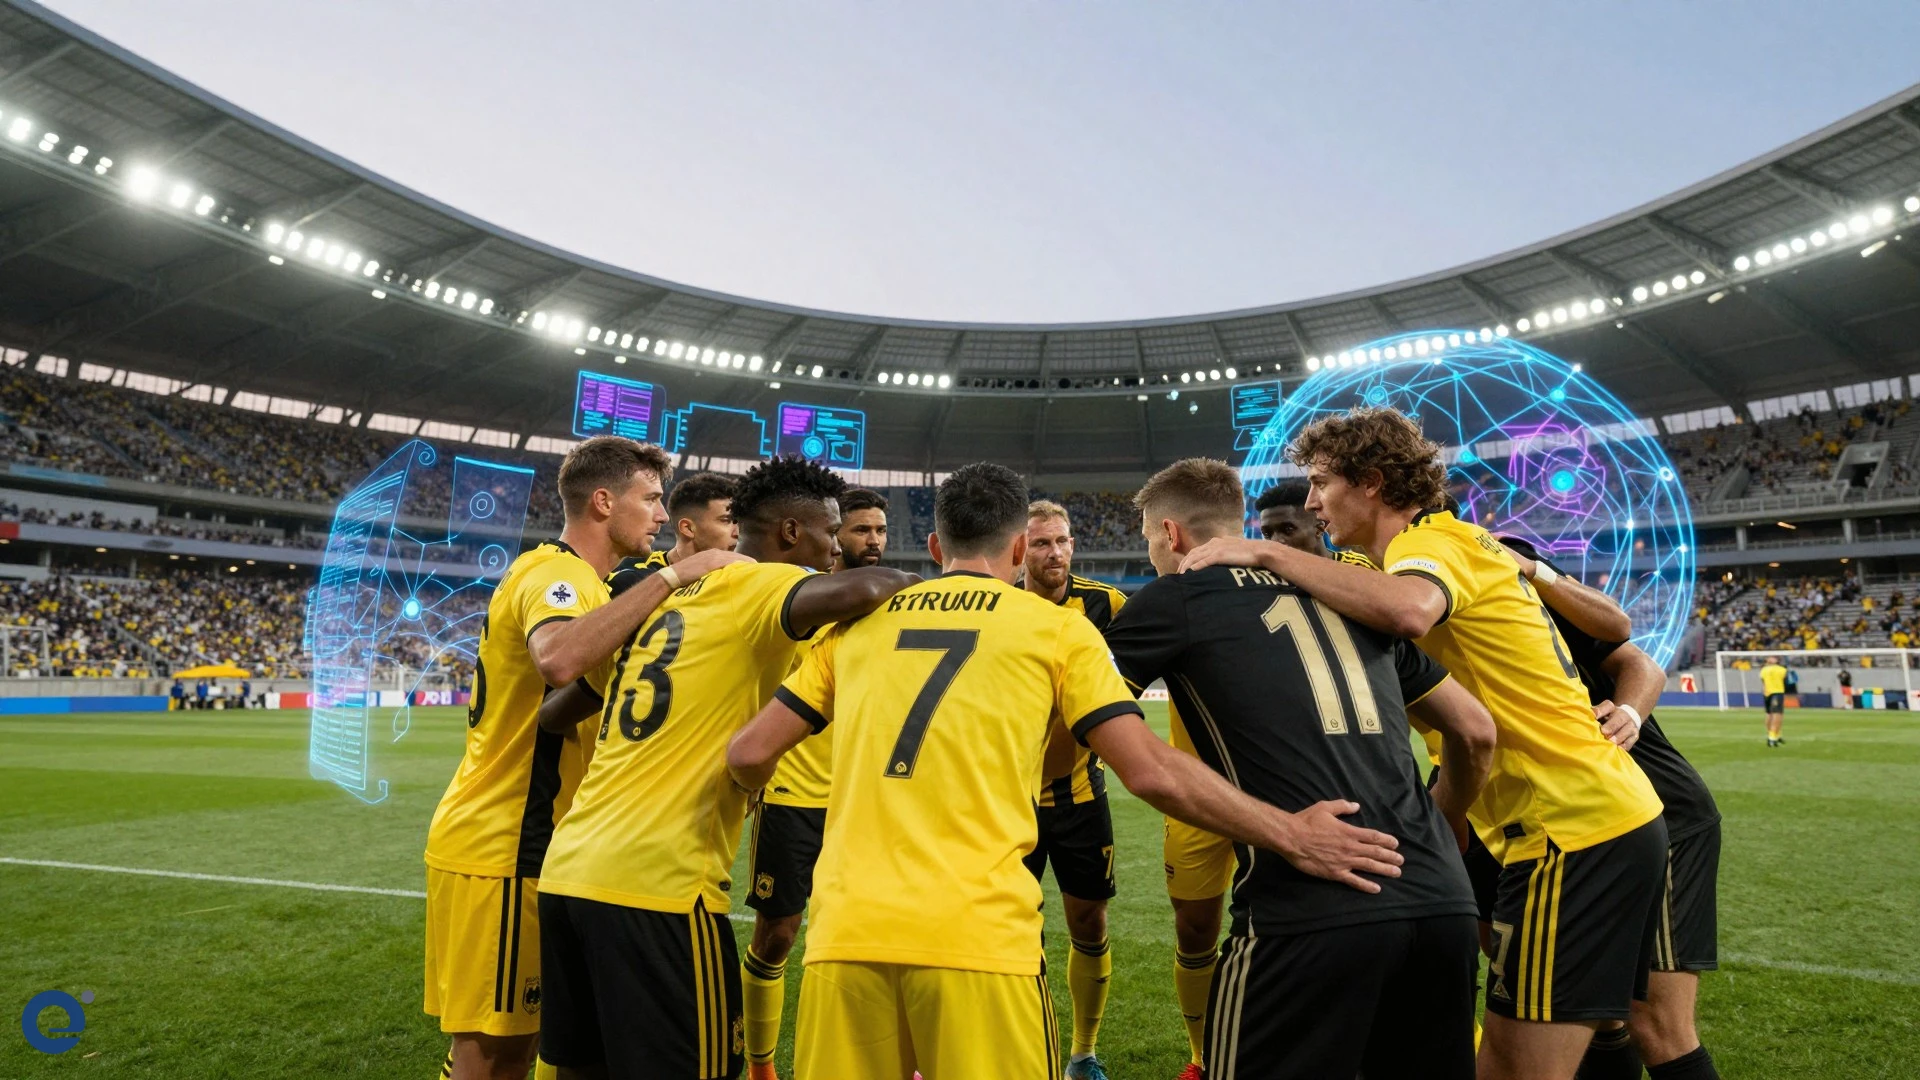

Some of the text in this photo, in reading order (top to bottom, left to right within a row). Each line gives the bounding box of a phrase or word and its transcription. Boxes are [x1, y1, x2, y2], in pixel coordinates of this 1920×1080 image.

[599, 609, 685, 745] 13
[883, 629, 980, 779] 7
[1260, 594, 1384, 735] 11
